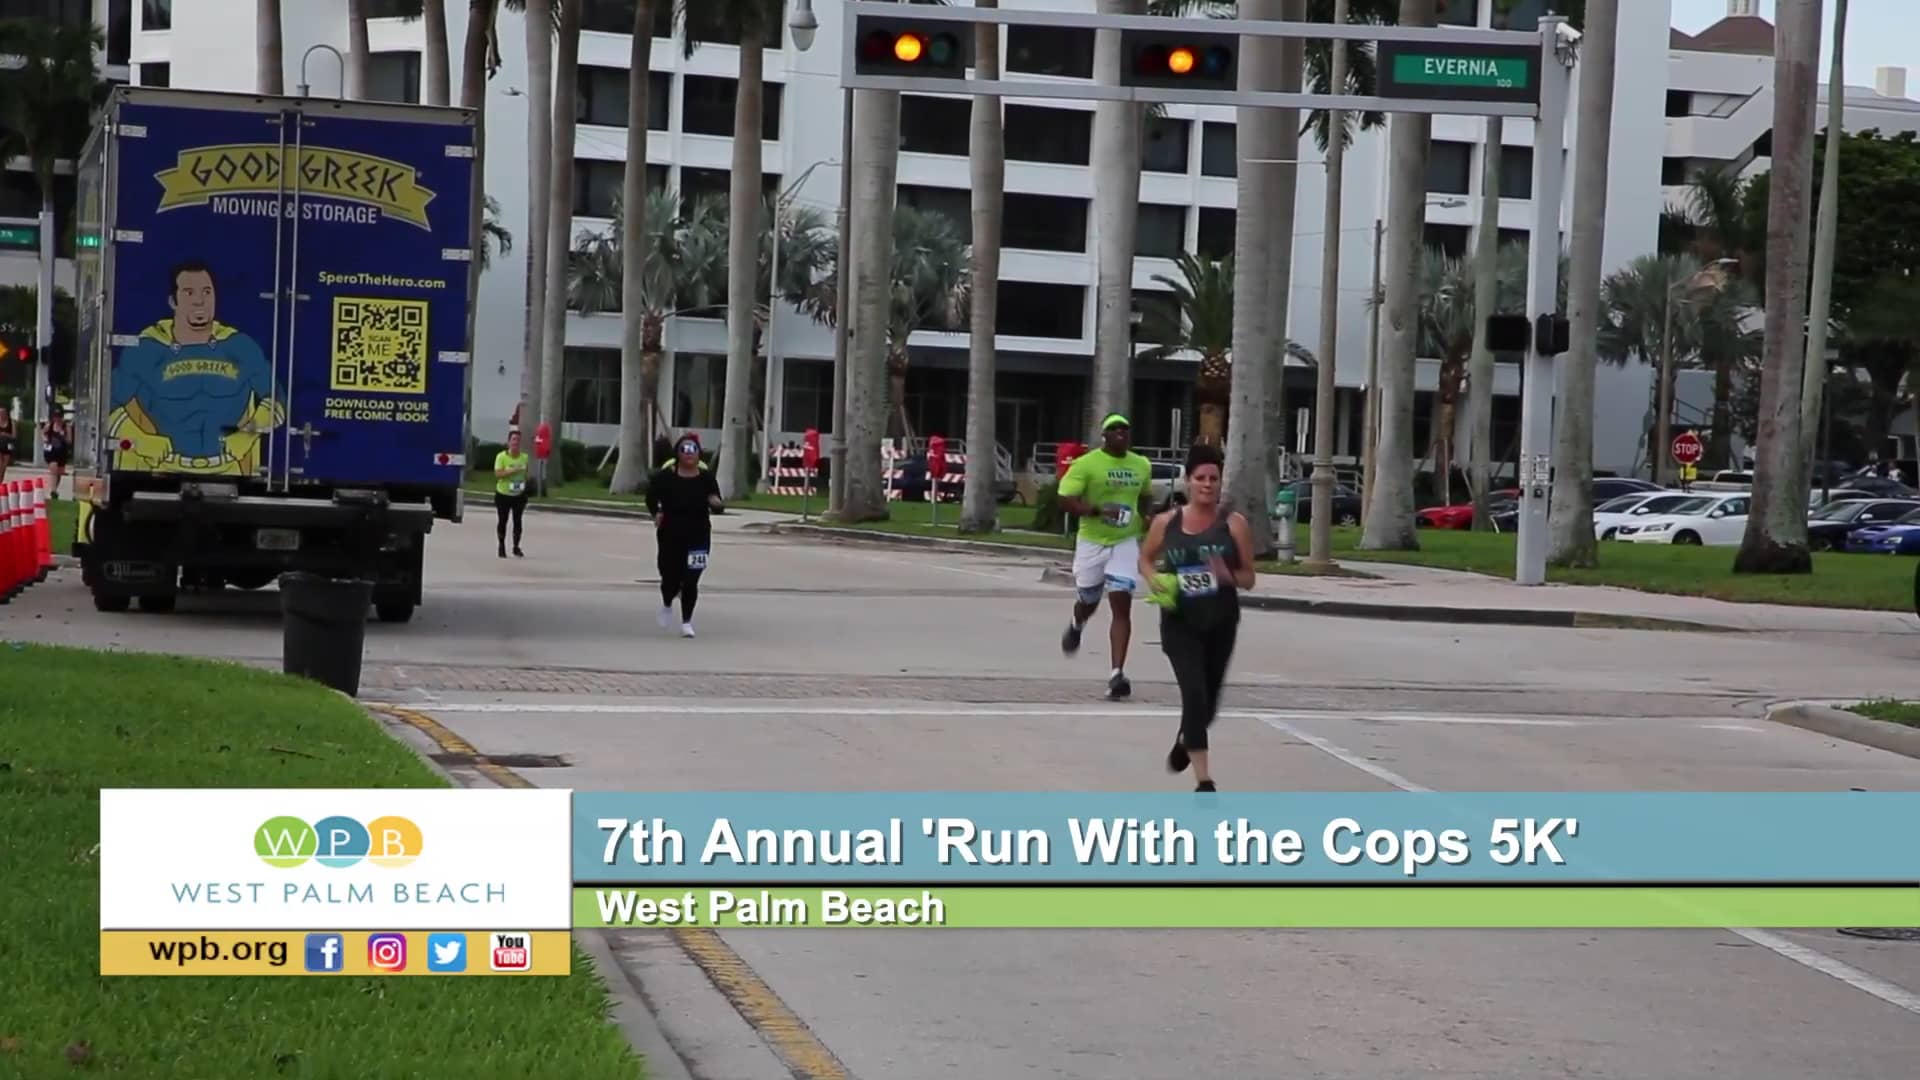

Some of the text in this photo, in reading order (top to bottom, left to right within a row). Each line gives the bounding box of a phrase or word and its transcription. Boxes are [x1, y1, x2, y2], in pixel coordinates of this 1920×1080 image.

[1424, 57, 1499, 77] EVERNIA
[190, 152, 404, 202] GOOD GREEK
[213, 197, 378, 225] MOVING & STORAGE
[318, 271, 446, 289] SperoTheHero.com
[367, 344, 391, 357] ME
[325, 398, 430, 412] DOWNLOAD YOUR
[324, 409, 430, 423] FREE COMIC BOOK
[1675, 443, 1699, 455] STOP
